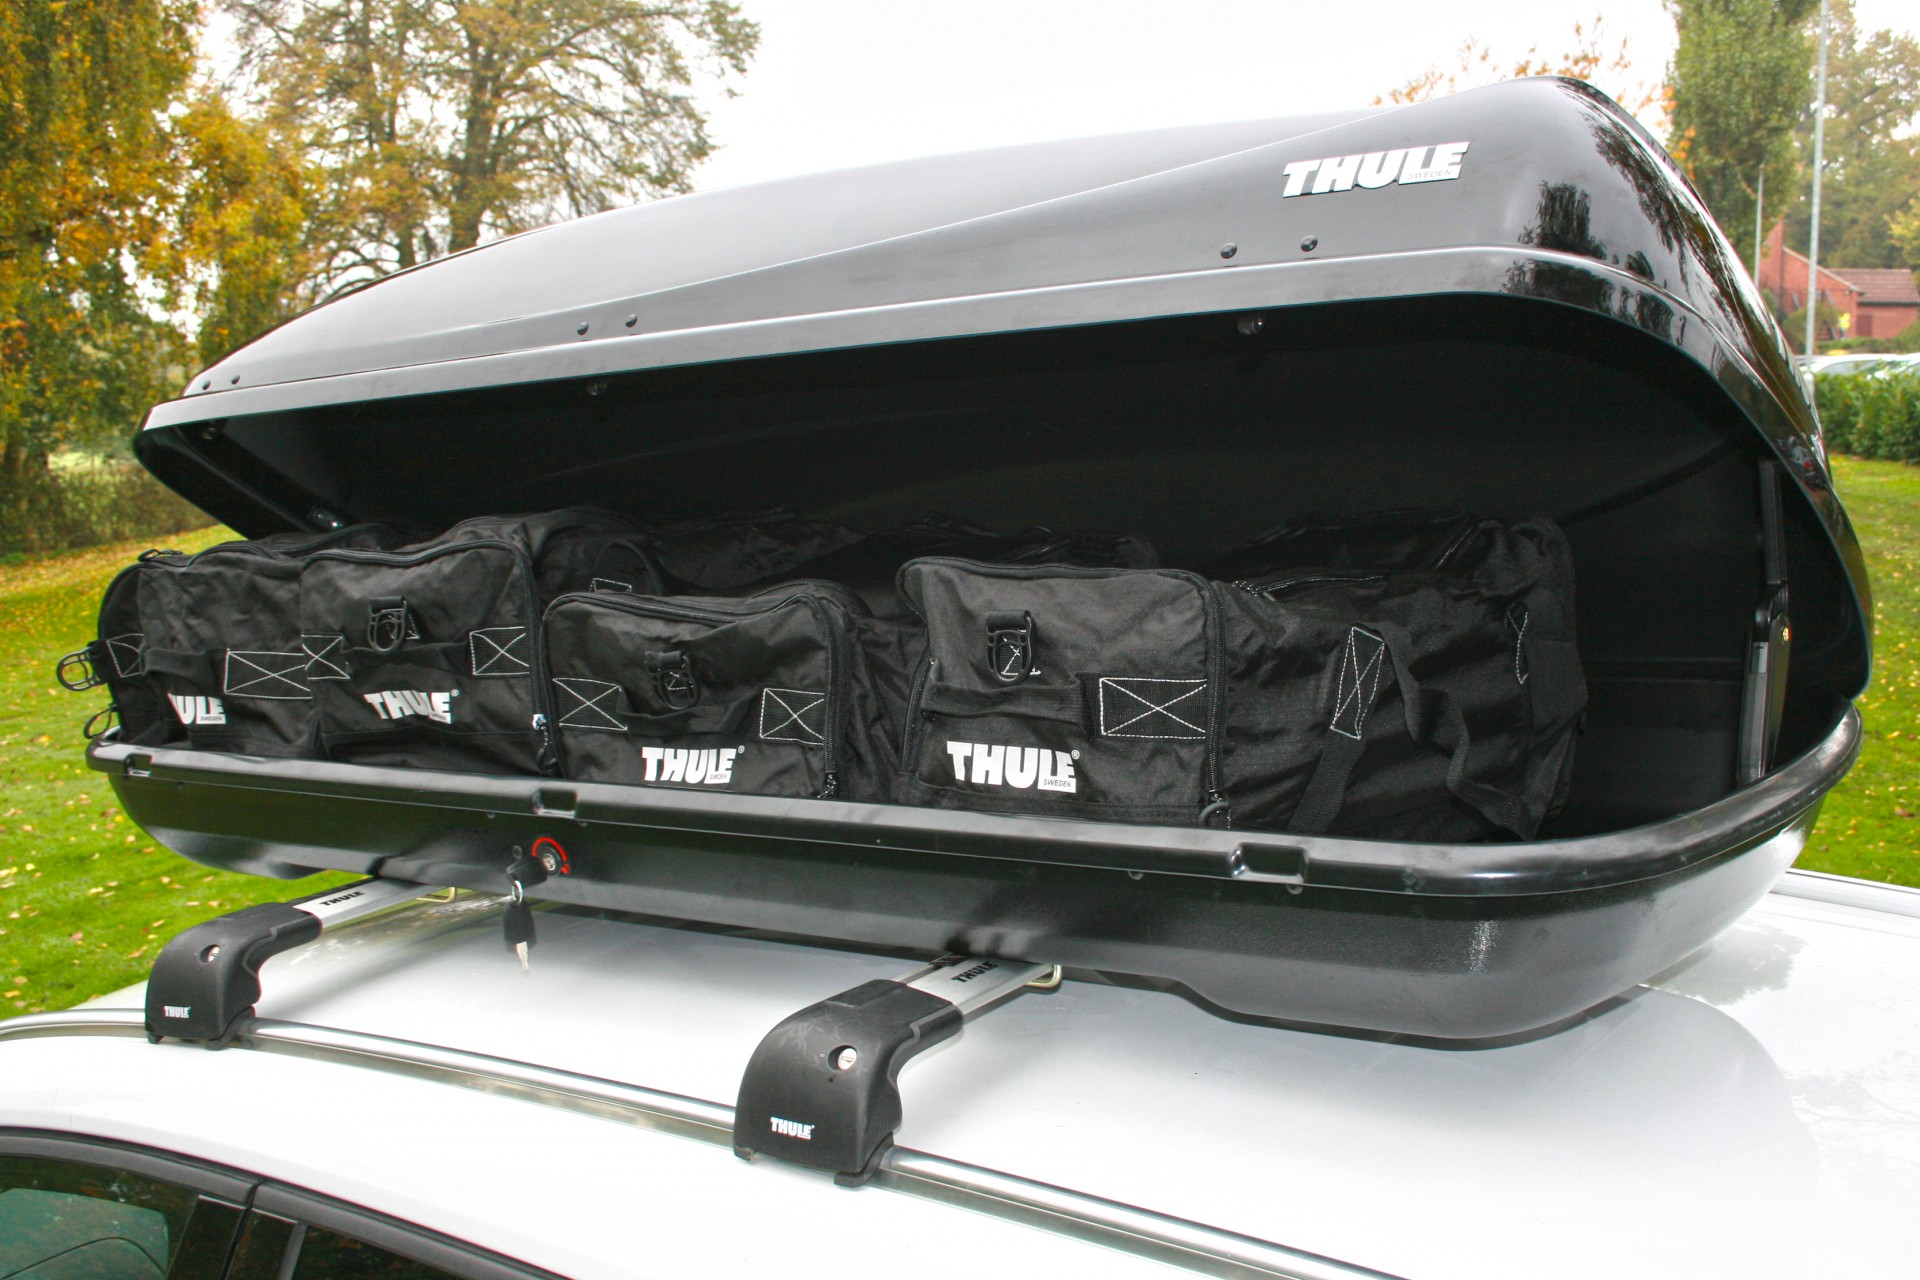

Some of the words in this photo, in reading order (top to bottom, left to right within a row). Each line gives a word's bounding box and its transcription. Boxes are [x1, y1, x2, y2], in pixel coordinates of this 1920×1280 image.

[1283, 142, 1470, 198] THULE
[1408, 170, 1452, 180] SWEDEN
[167, 693, 227, 725] ULE
[363, 690, 452, 724] THULE
[642, 747, 737, 784] THULE
[946, 741, 1077, 793] THULE
[1043, 778, 1072, 788] SWEDEN
[319, 890, 366, 906] THULE
[950, 960, 999, 982] THULE
[164, 1005, 190, 1018] THULE
[770, 1116, 812, 1140] THULE
